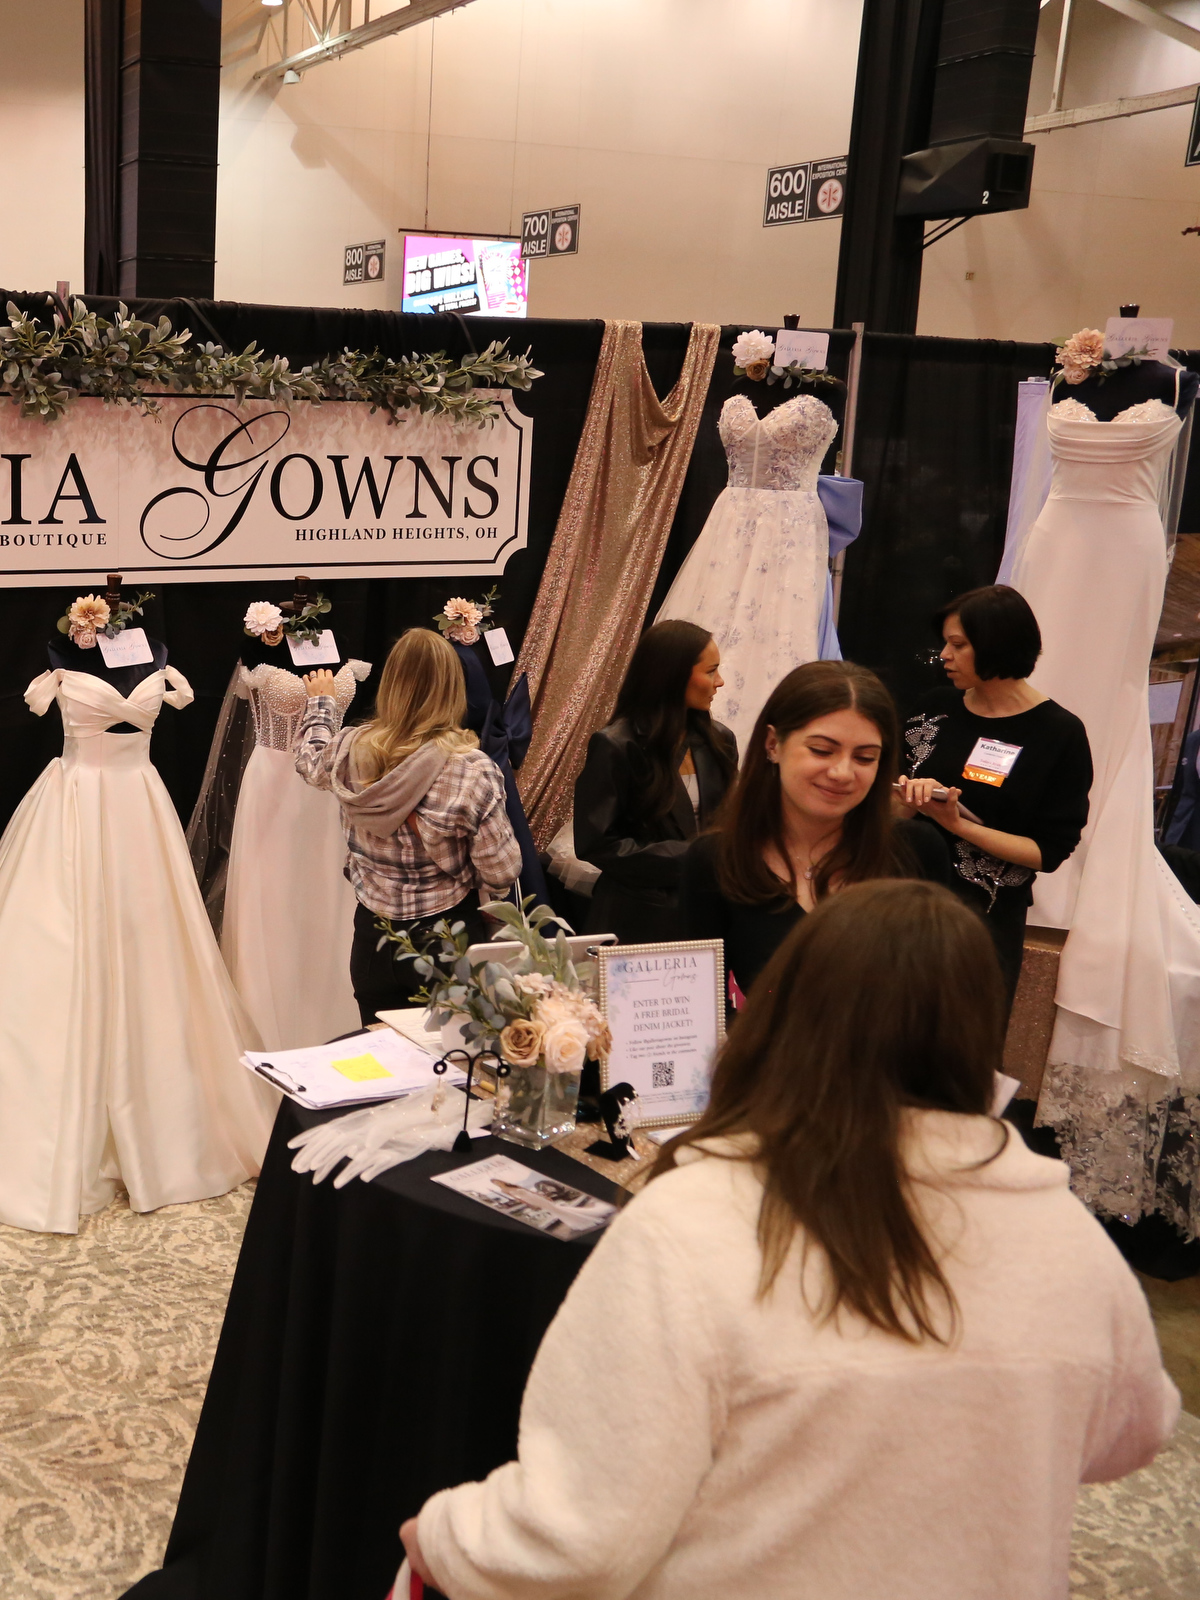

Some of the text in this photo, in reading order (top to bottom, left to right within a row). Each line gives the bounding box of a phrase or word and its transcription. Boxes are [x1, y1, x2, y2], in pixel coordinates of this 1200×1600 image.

[769, 169, 806, 198] 600
[981, 190, 990, 205] 2
[767, 200, 804, 220] AISLE
[524, 215, 548, 237] 700
[522, 239, 547, 255] AISLE
[345, 248, 363, 266] 800
[345, 268, 362, 282] AISLE
[139, 404, 500, 560] GOWNS
[0, 533, 107, 549] BOUTIQUE
[295, 527, 499, 542] HIGHLAND HEIGHTS, OH
[980, 743, 1016, 755] Katharine
[623, 957, 698, 974] GALLERIA
[633, 995, 690, 1008] ENTER TO WIN
[641, 1010, 660, 1019] FREE
[662, 1007, 690, 1017] BRIDAL
[633, 1022, 660, 1032] DENIM
